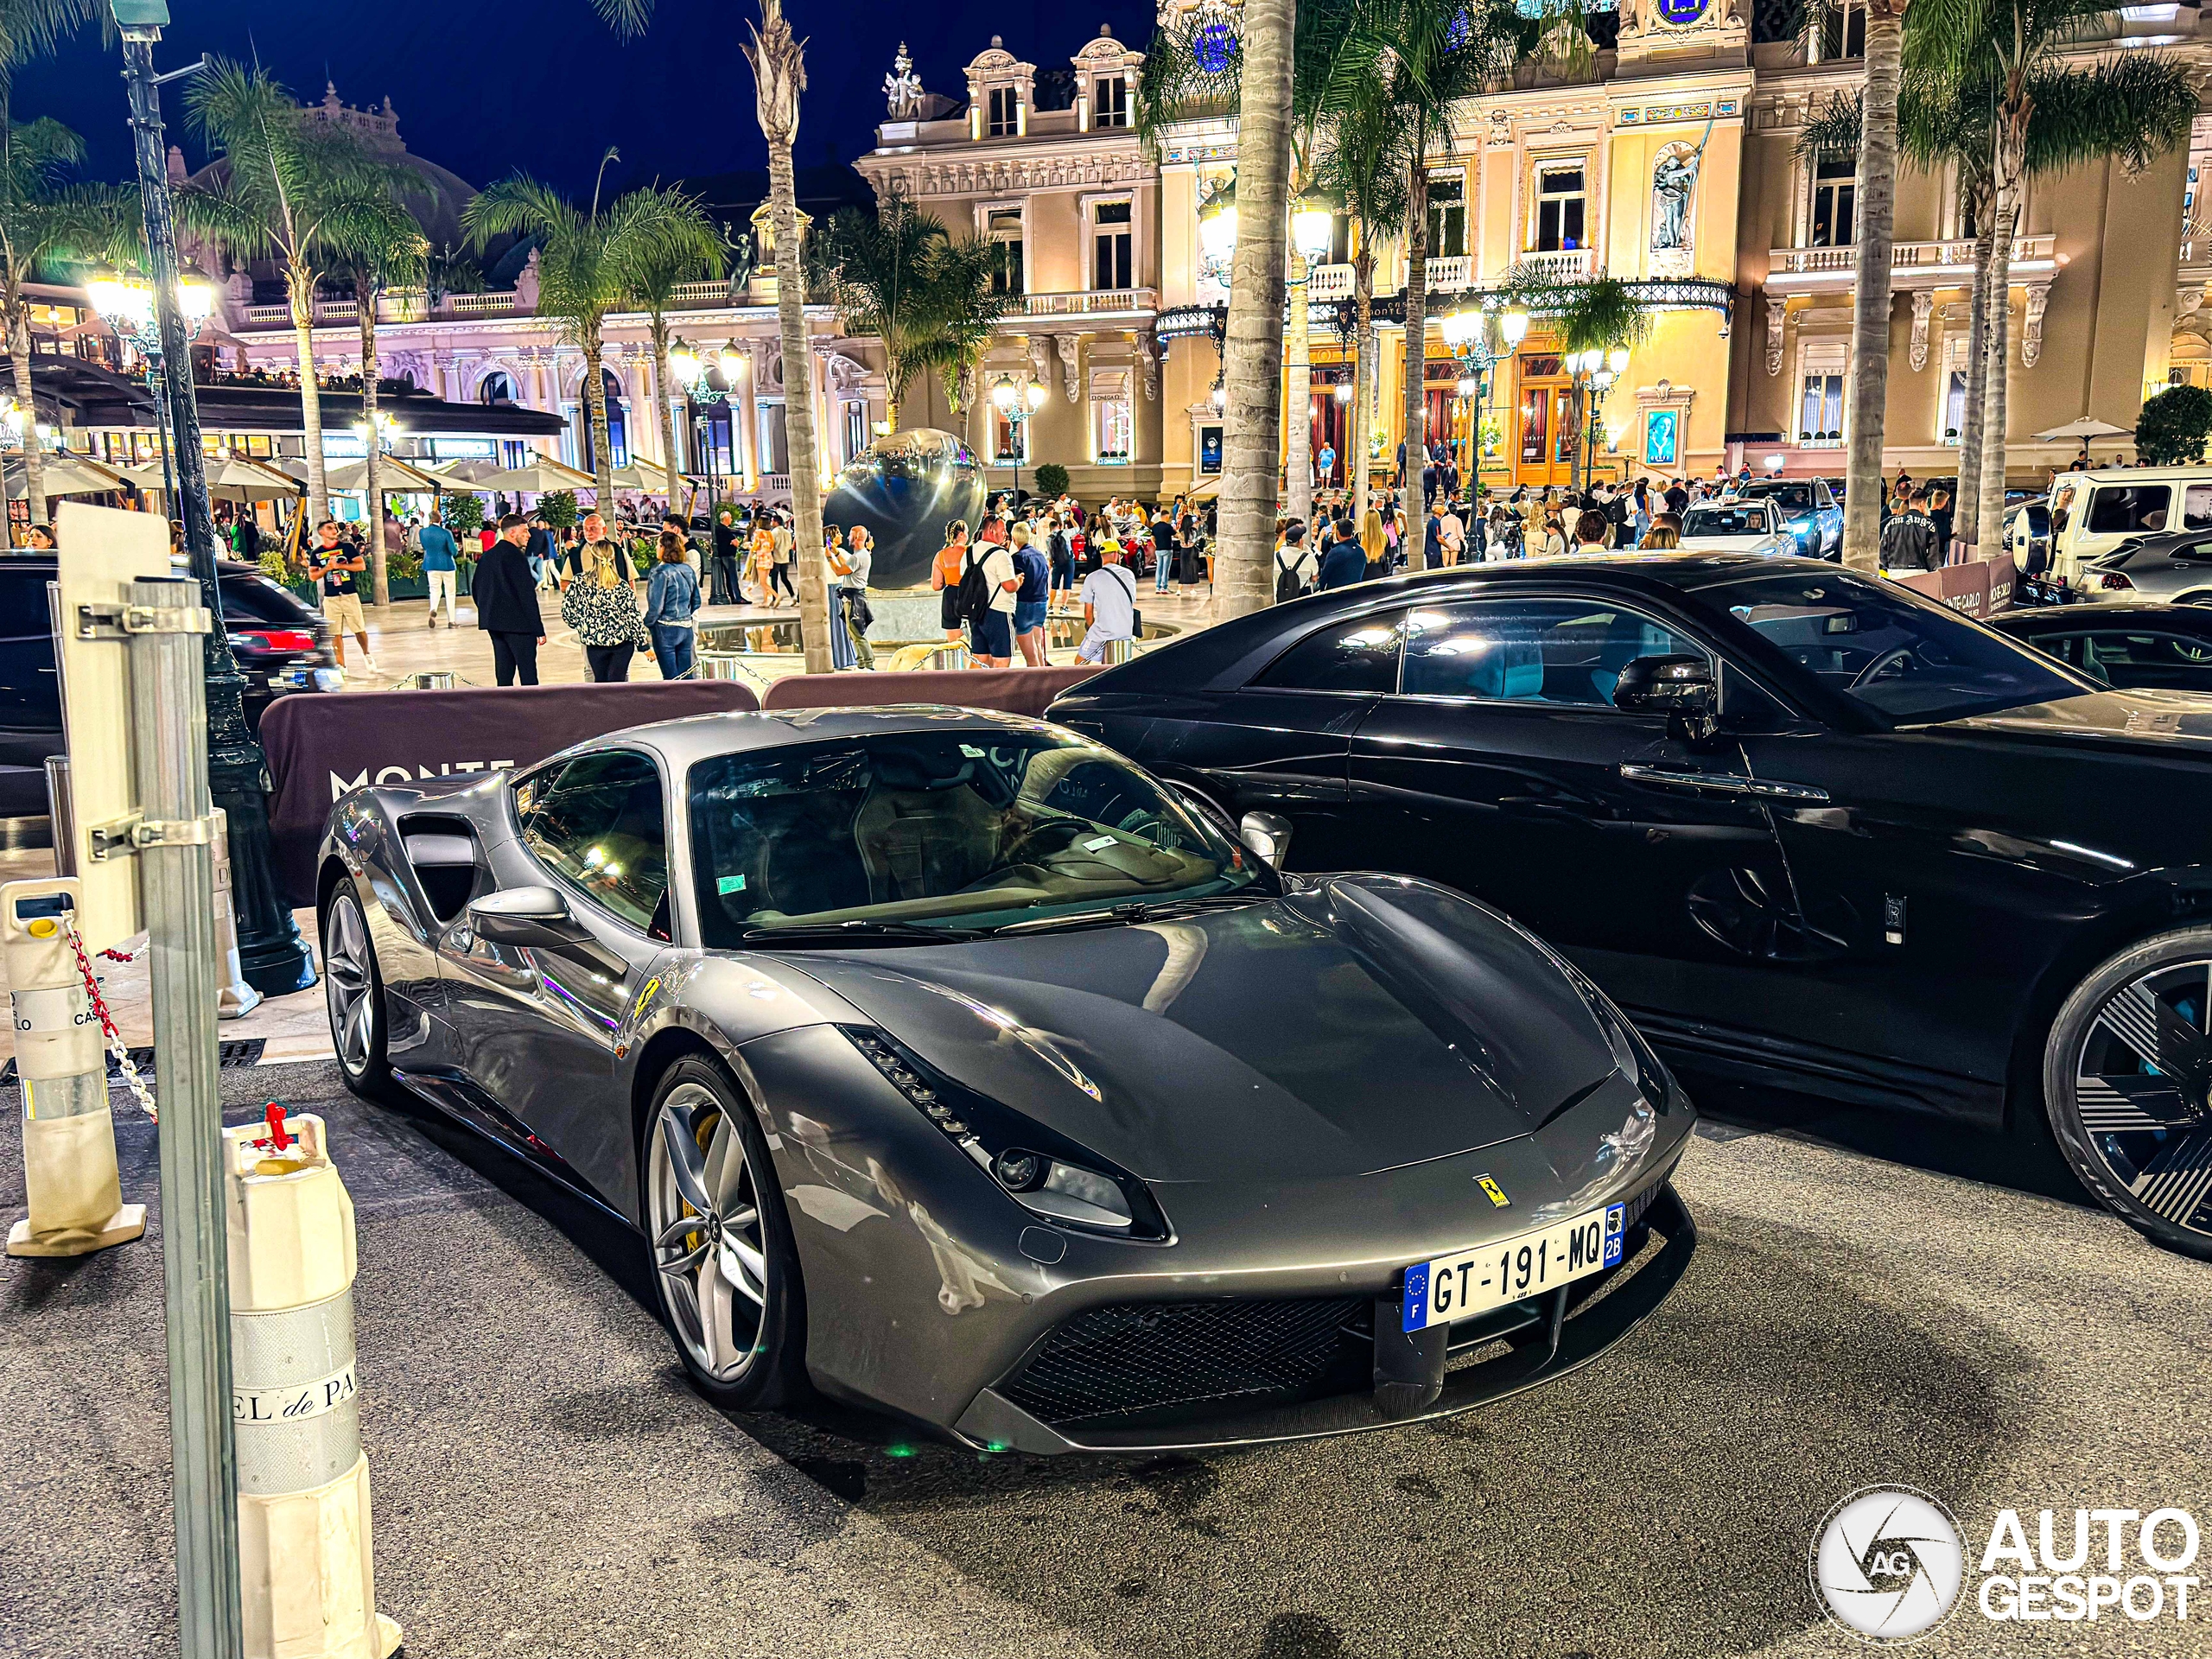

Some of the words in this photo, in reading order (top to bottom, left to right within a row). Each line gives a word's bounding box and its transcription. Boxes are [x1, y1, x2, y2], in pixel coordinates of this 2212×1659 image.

[1801, 439, 1840, 448] GRAFF
[1411, 1303, 1420, 1319] F
[1433, 1221, 1600, 1313] GT-191-MQ
[1605, 1237, 1621, 1260] 2B
[283, 1390, 315, 1419] de
